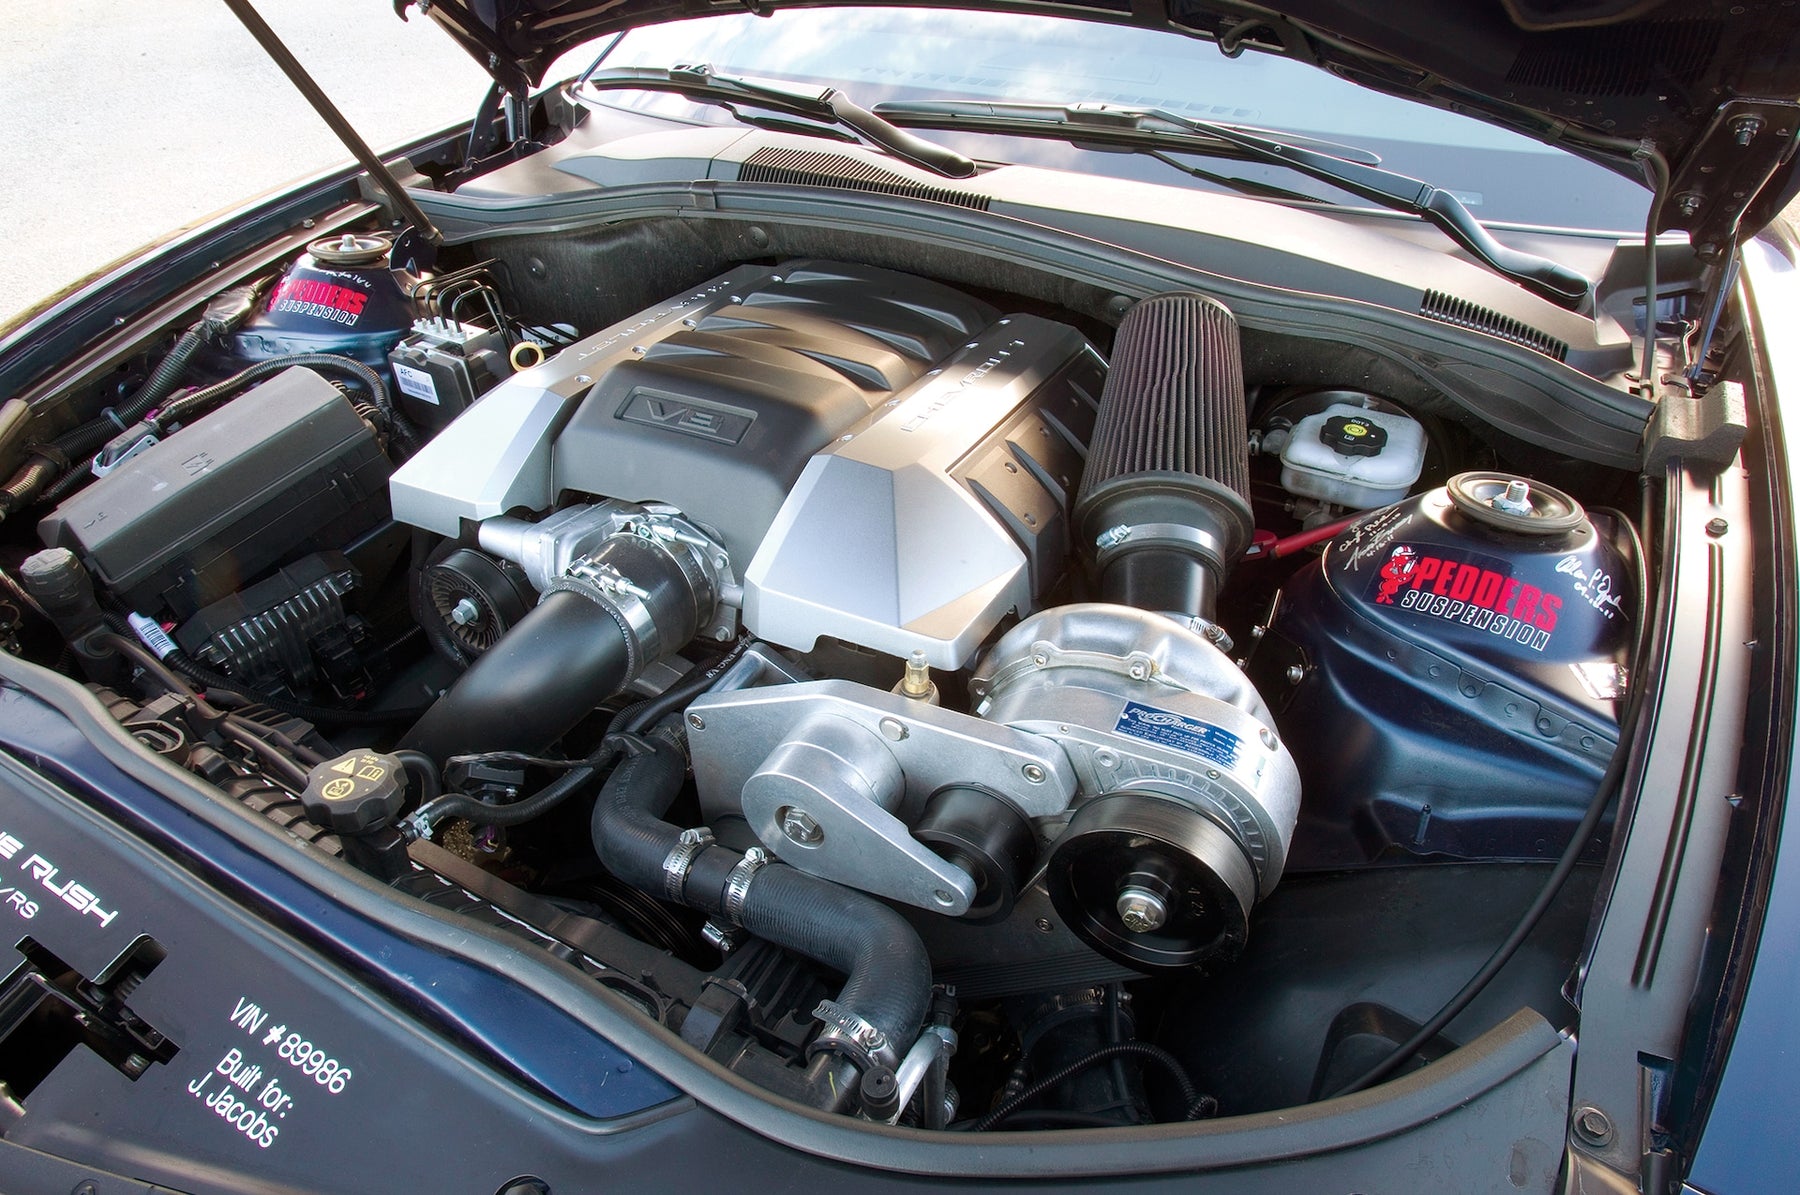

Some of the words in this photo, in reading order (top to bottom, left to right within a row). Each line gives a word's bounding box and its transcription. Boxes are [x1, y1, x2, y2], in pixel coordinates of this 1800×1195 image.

[279, 299, 359, 326] SUSPENSION
[285, 279, 368, 315] PEDDERS
[646, 399, 726, 433] V8
[1401, 590, 1550, 651] SUSPENSION
[1411, 557, 1563, 633] PEDDERS
[1128, 708, 1208, 735] PROCHARGER
[20, 853, 118, 928] RUSH
[230, 996, 269, 1035] VIN
[262, 1024, 352, 1094] #89986
[187, 1071, 213, 1098] J.
[205, 1084, 279, 1148] Jacobs
[215, 1047, 262, 1093] Built
[257, 1078, 294, 1119] for:
